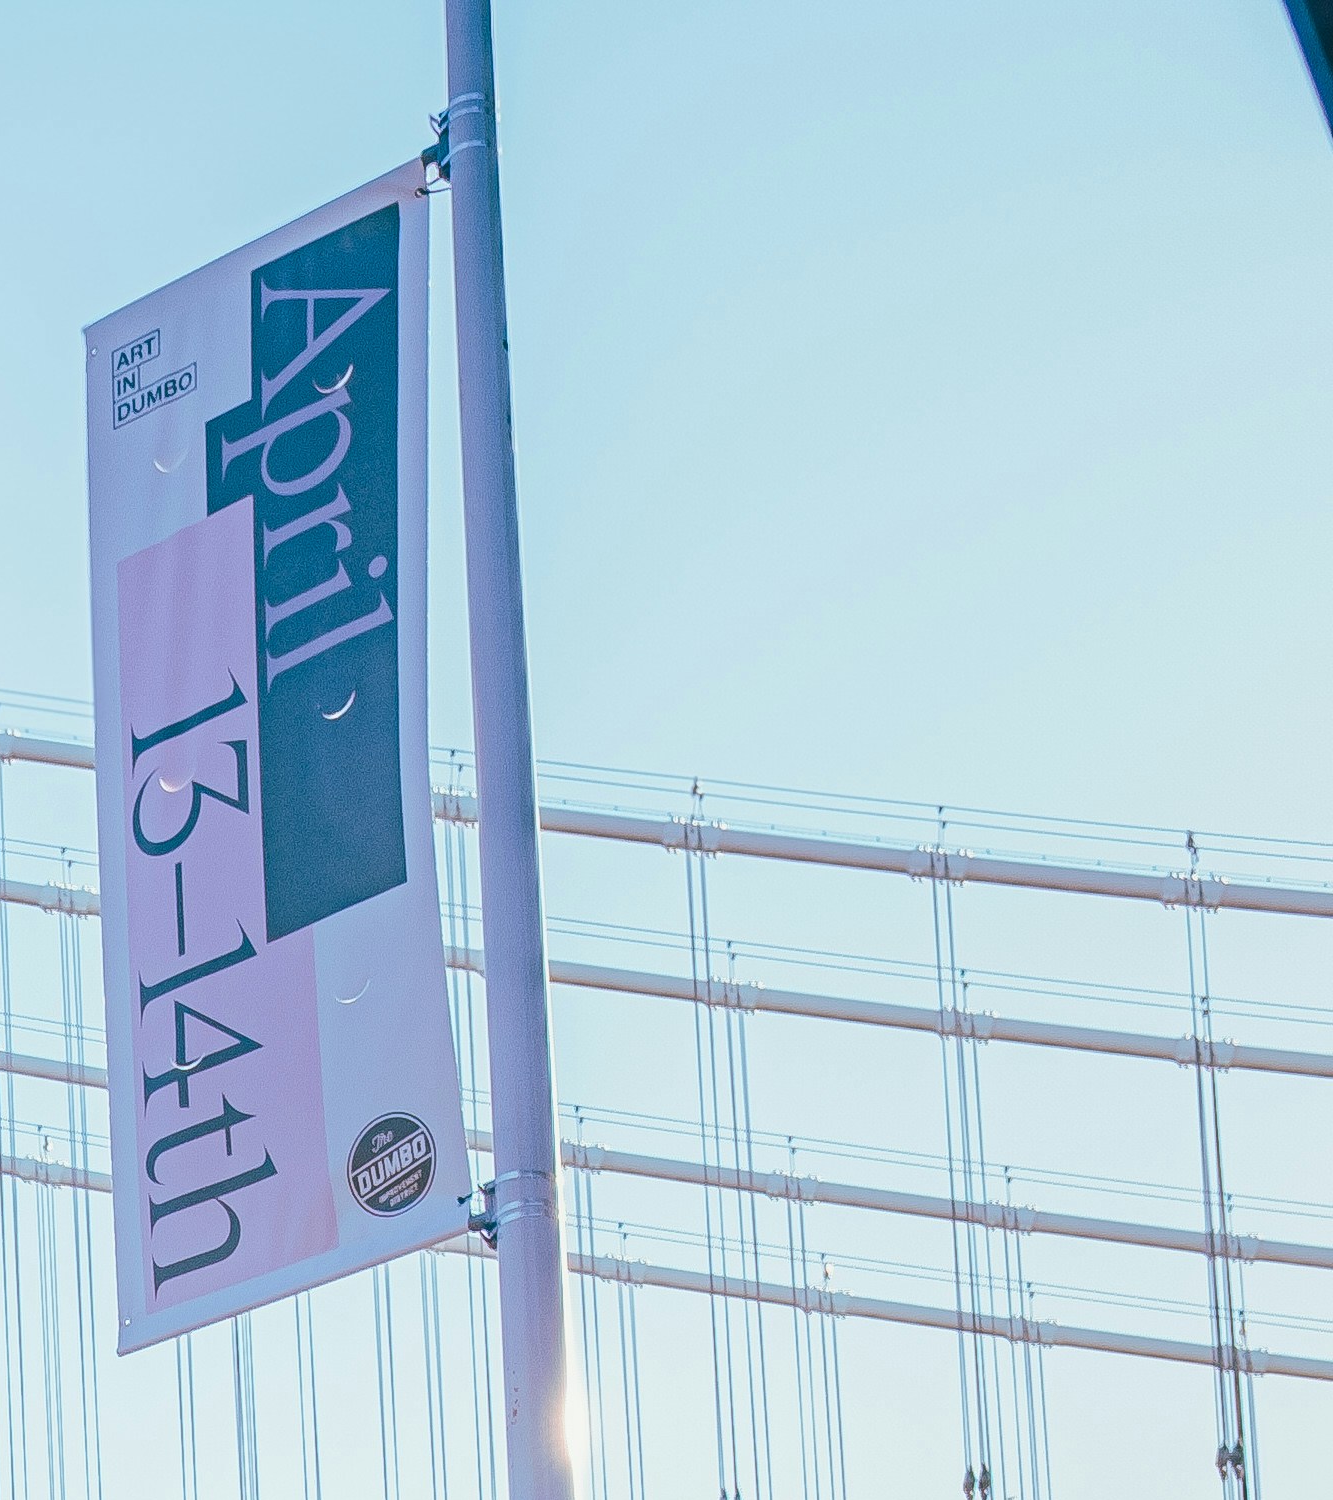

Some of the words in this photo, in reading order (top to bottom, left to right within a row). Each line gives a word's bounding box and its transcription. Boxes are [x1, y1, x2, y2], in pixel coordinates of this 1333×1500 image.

[116, 336, 156, 371] ART
[117, 371, 136, 396] IN
[118, 372, 193, 422] DUMBO
[219, 277, 396, 695] April
[357, 1133, 427, 1197] DUMBO
